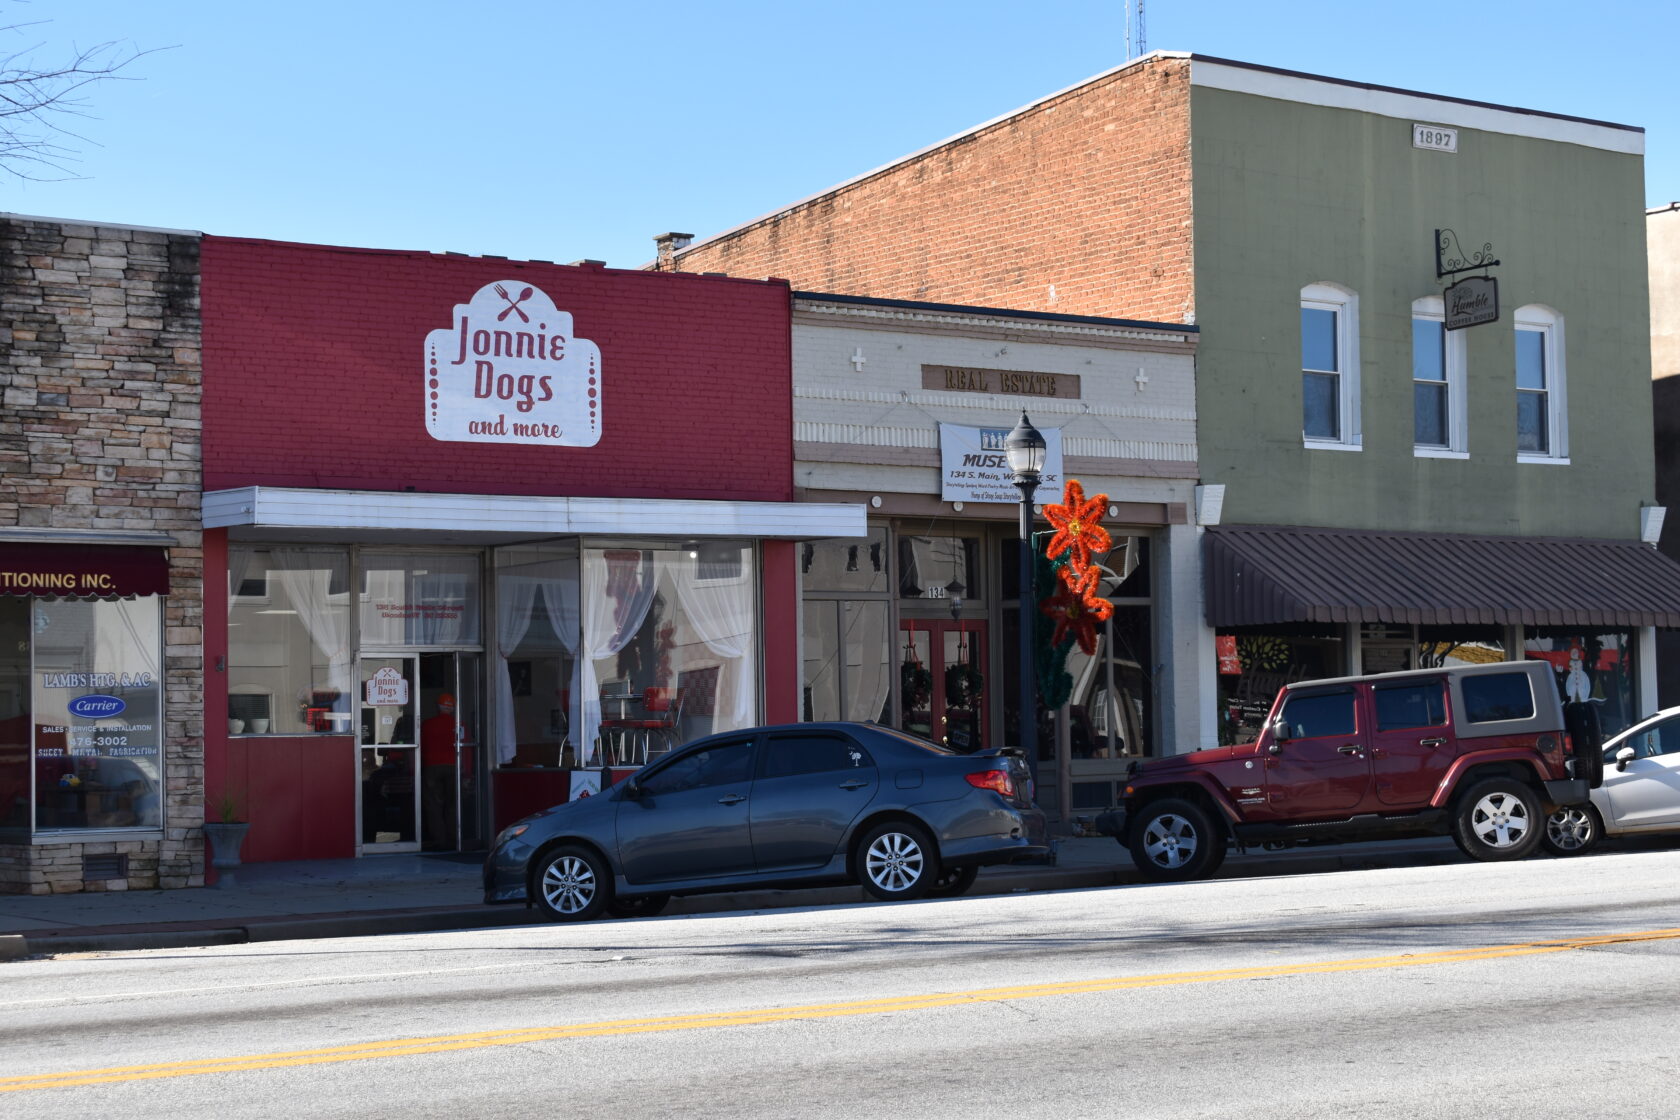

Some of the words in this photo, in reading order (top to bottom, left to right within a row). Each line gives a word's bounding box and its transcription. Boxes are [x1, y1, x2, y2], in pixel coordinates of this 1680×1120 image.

[1419, 130, 1451, 147] 1897
[1451, 293, 1488, 315] Humble
[1449, 317, 1471, 327] COFFEE
[451, 316, 566, 365] Jonnie
[474, 360, 553, 413] Dogs
[944, 368, 989, 392] REAL
[1000, 372, 1057, 396] ESTATE
[469, 414, 508, 437] and
[513, 422, 563, 439] more
[963, 453, 1007, 469] MUSE
[950, 470, 966, 478] 134
[968, 471, 976, 479] S.
[978, 473, 1001, 481] Main,
[1046, 474, 1057, 482] SC
[81, 573, 116, 589] INC.
[929, 587, 944, 598] 134
[44, 672, 86, 688] LAMB'S
[90, 672, 118, 688] HTG.
[120, 672, 131, 688] &
[133, 672, 151, 688] AC
[374, 676, 399, 688] Jonnie
[378, 686, 397, 697] Dogs
[76, 700, 118, 711] Carrier
[69, 736, 127, 746] 476-3002
[38, 748, 63, 757] SHEET
[71, 748, 102, 757] METAL
[109, 747, 157, 756] FABRICATION
